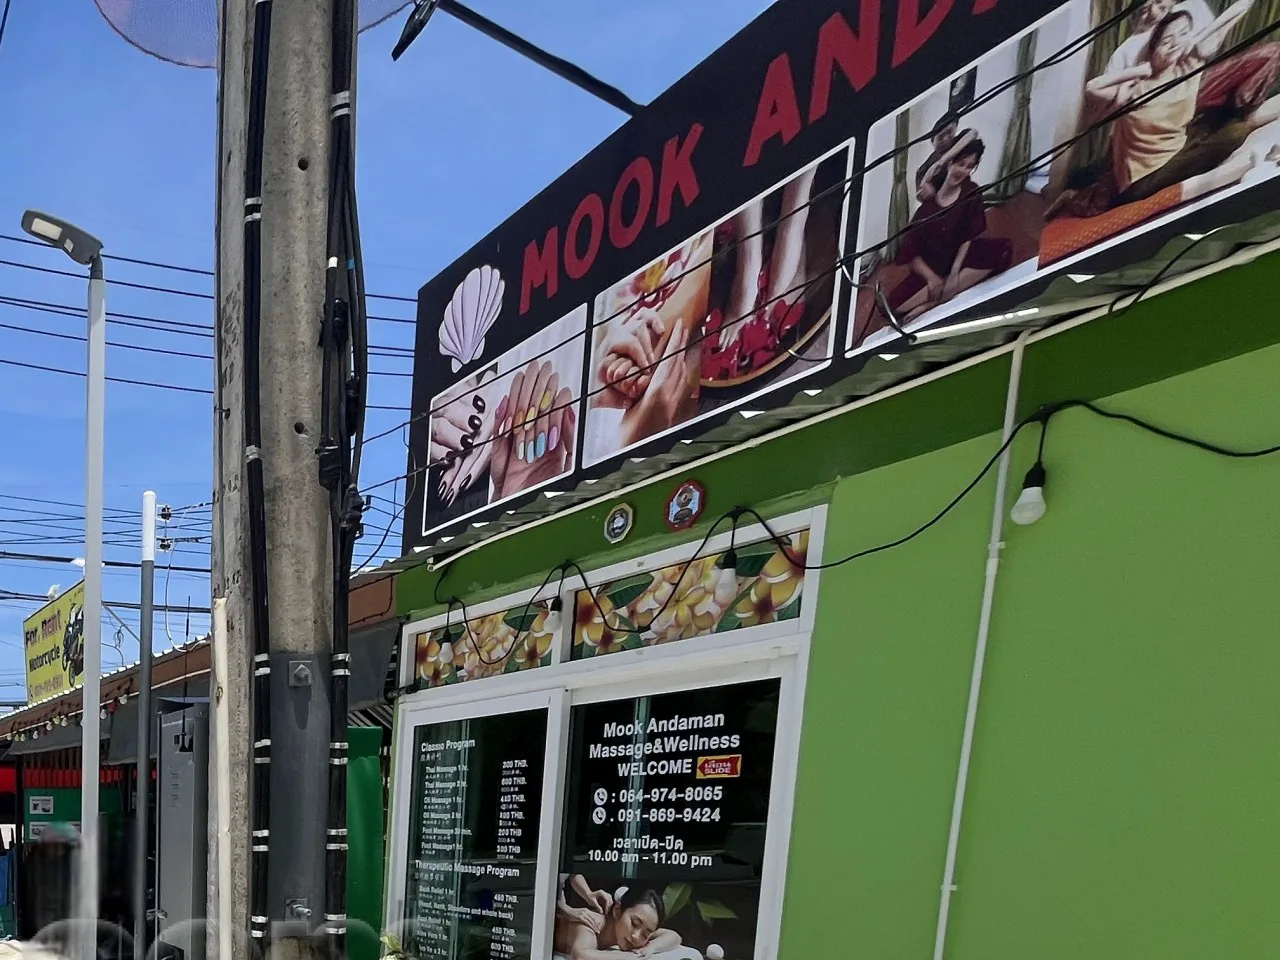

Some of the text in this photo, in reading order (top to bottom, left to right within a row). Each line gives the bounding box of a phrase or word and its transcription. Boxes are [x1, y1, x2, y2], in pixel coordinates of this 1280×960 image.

[520, 0, 998, 316] MOOK AND
[604, 714, 725, 738] Mook Andaman
[446, 739, 475, 751] Program
[589, 734, 740, 759] Massage&Wellness
[618, 759, 693, 776] WELCOME
[619, 786, 723, 803] 064-974-8065
[618, 807, 721, 823] 091-869-9424
[588, 850, 619, 862] 10.00
[621, 853, 639, 863] am
[652, 852, 688, 865] 11.00
[691, 855, 713, 868] pm
[454, 862, 485, 876] Massage
[487, 865, 520, 878] Program
